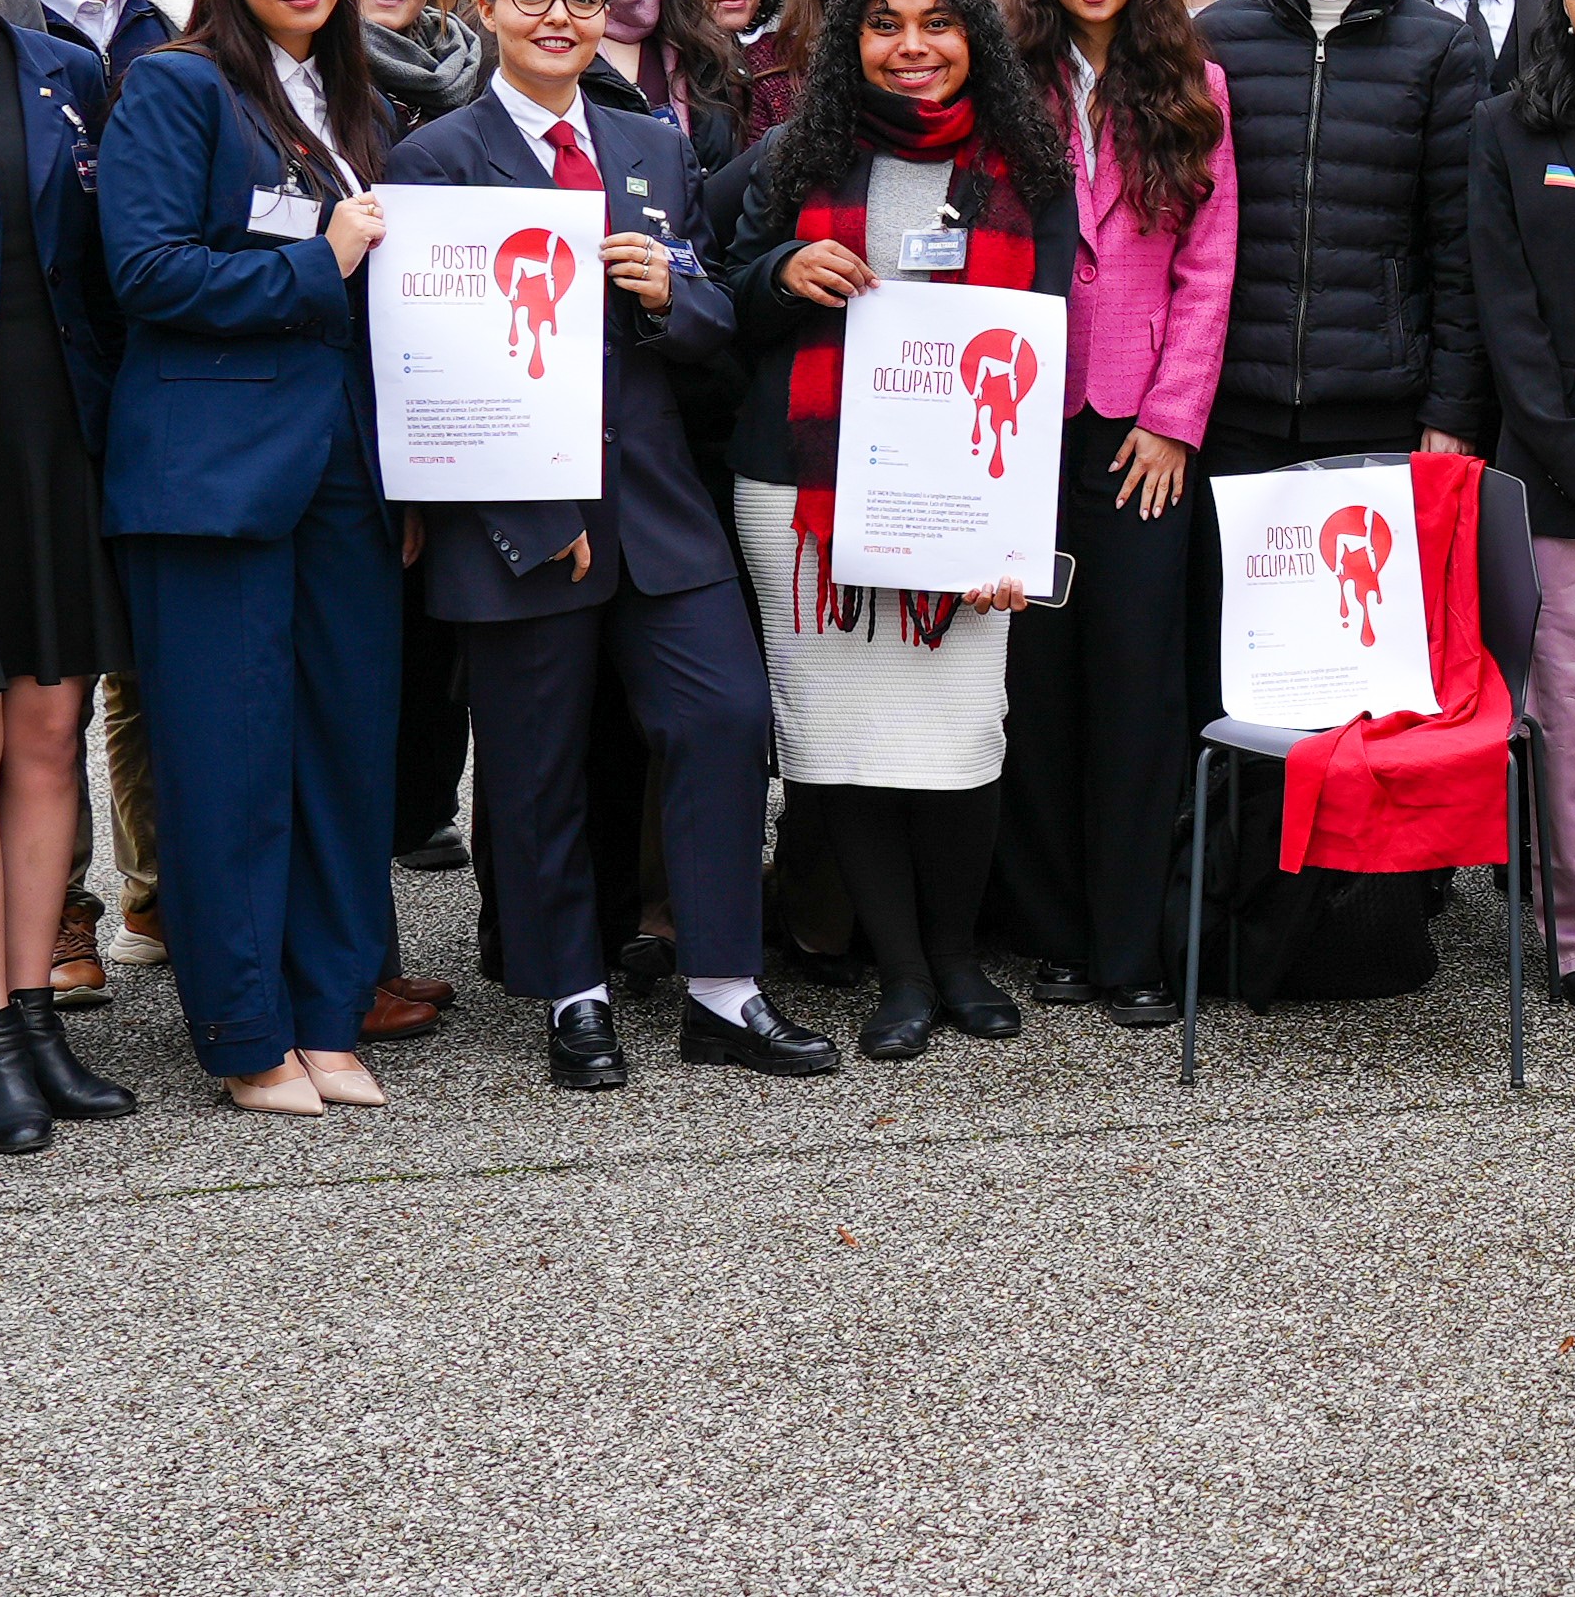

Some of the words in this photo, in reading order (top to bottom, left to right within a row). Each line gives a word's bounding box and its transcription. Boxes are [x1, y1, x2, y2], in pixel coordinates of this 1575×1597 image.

[431, 245, 487, 270] POSTO
[401, 273, 487, 299] OCCUPATO
[902, 340, 956, 367] POSTO
[873, 367, 954, 396] OCCUPATO
[1266, 525, 1313, 550] POSTO
[1246, 552, 1315, 578] OCCUPATO
